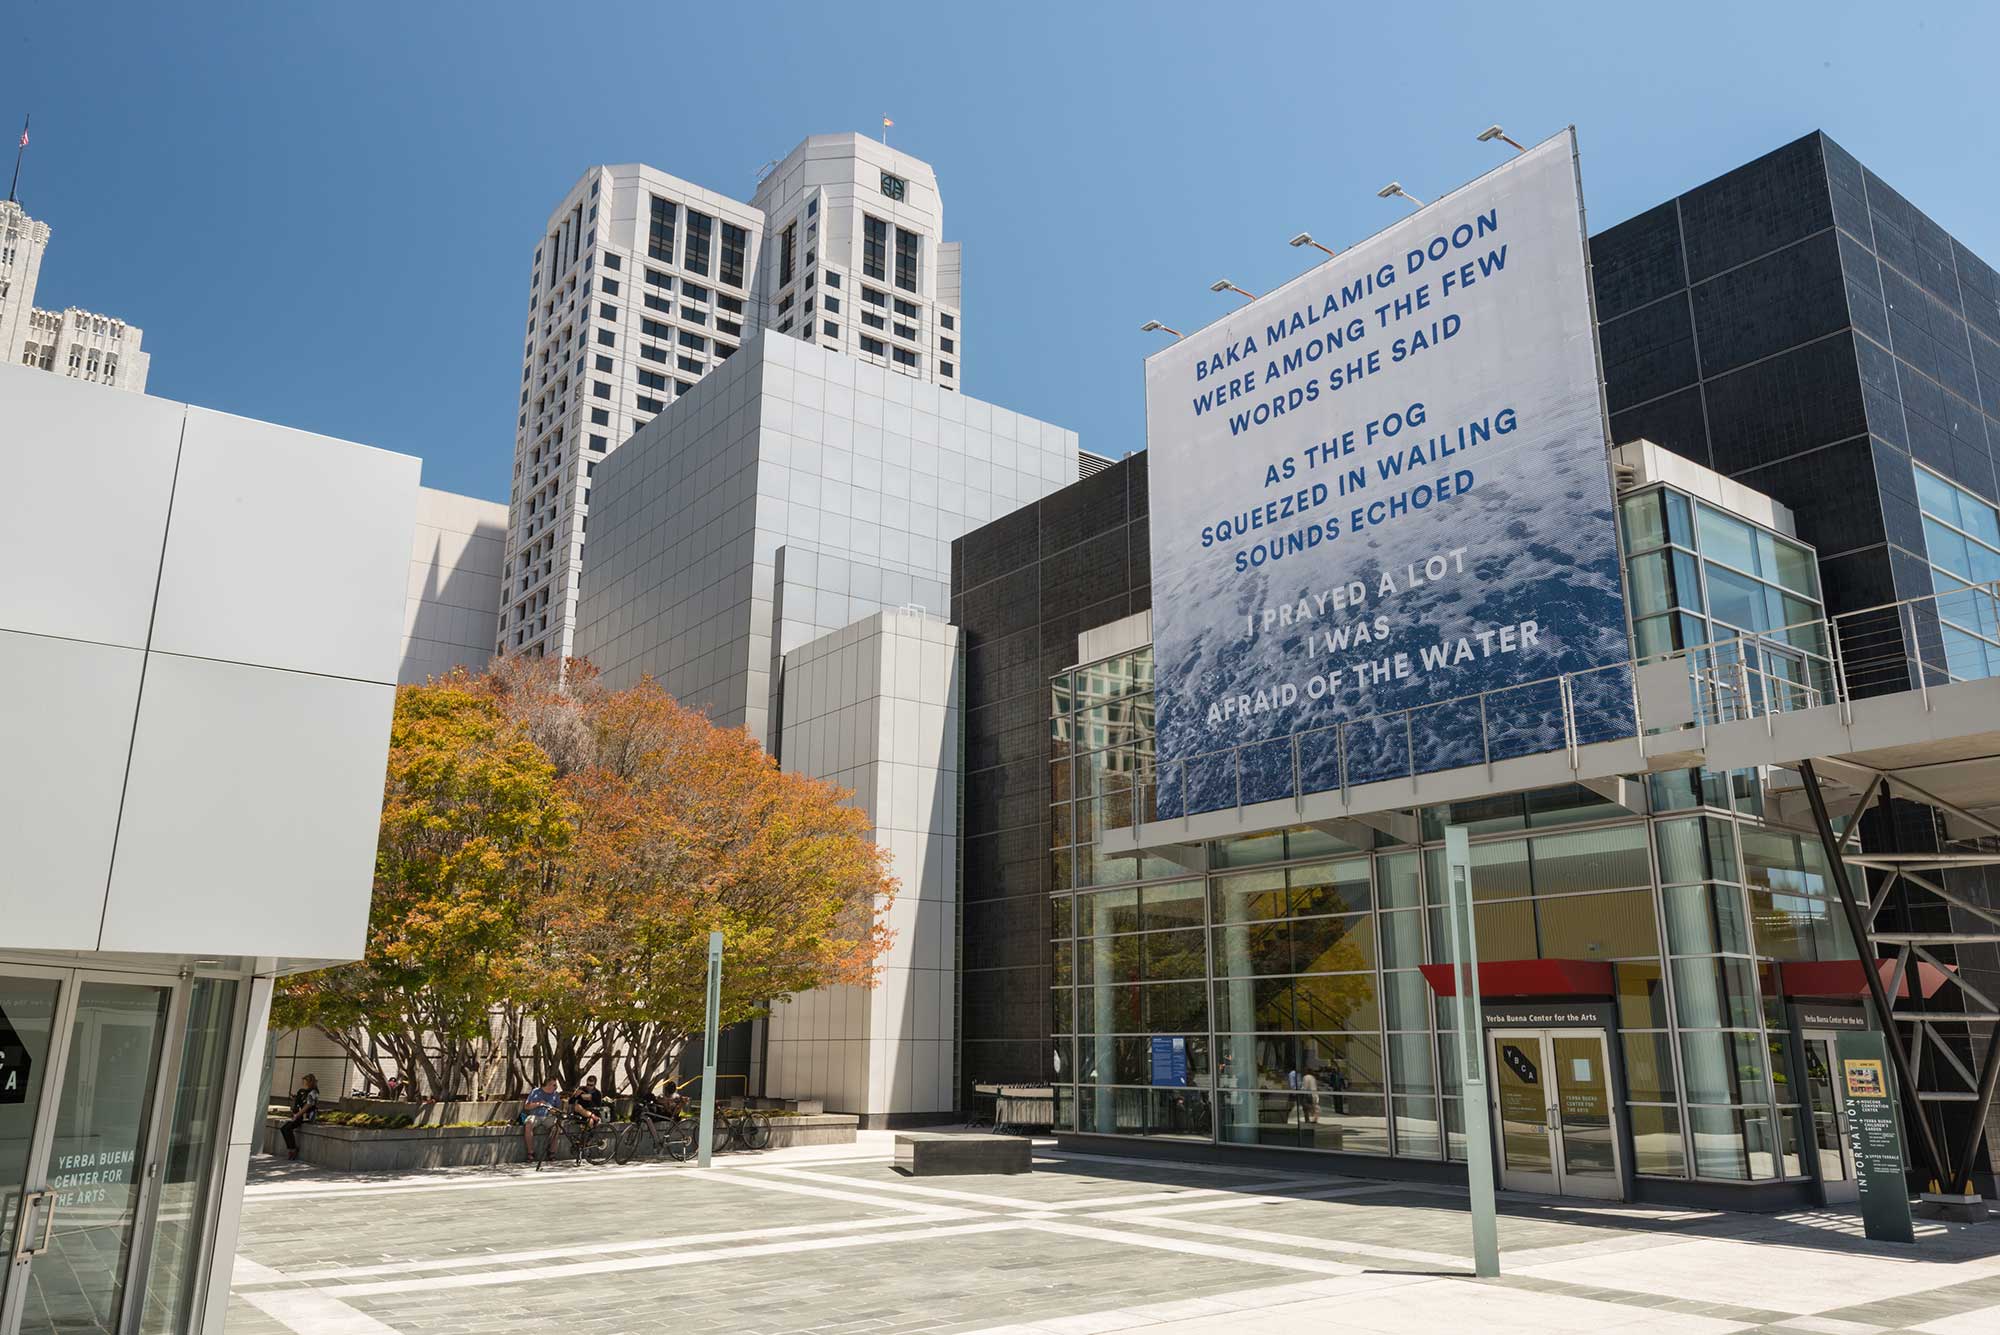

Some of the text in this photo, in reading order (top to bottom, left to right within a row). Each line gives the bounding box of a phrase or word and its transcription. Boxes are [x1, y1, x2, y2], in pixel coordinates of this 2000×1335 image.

[1192, 244, 1507, 416] WERE AMONG THE FEW
[1196, 208, 1498, 382] BAKA MALAMIG DOON
[1229, 314, 1461, 436] WORDS SHE SAID
[1201, 408, 1517, 548] SQUEEZED IN WAILING
[1264, 403, 1426, 488] AS THE FOG
[1235, 470, 1474, 573] SOUNDS ECHOED
[1247, 546, 1467, 636] I PRAYED A LOT
[1206, 620, 1539, 725] AFRAID OF THE WATER
[1308, 615, 1390, 659] I WAS
[1486, 1013, 1597, 1022] Yerba Buena Center for the Arts
[54, 1168, 123, 1189] CENTER FOR
[59, 1150, 134, 1170] YERBA BUENA
[1846, 1099, 1868, 1192] INFORMATION
[77, 1188, 105, 1204] ARTS
